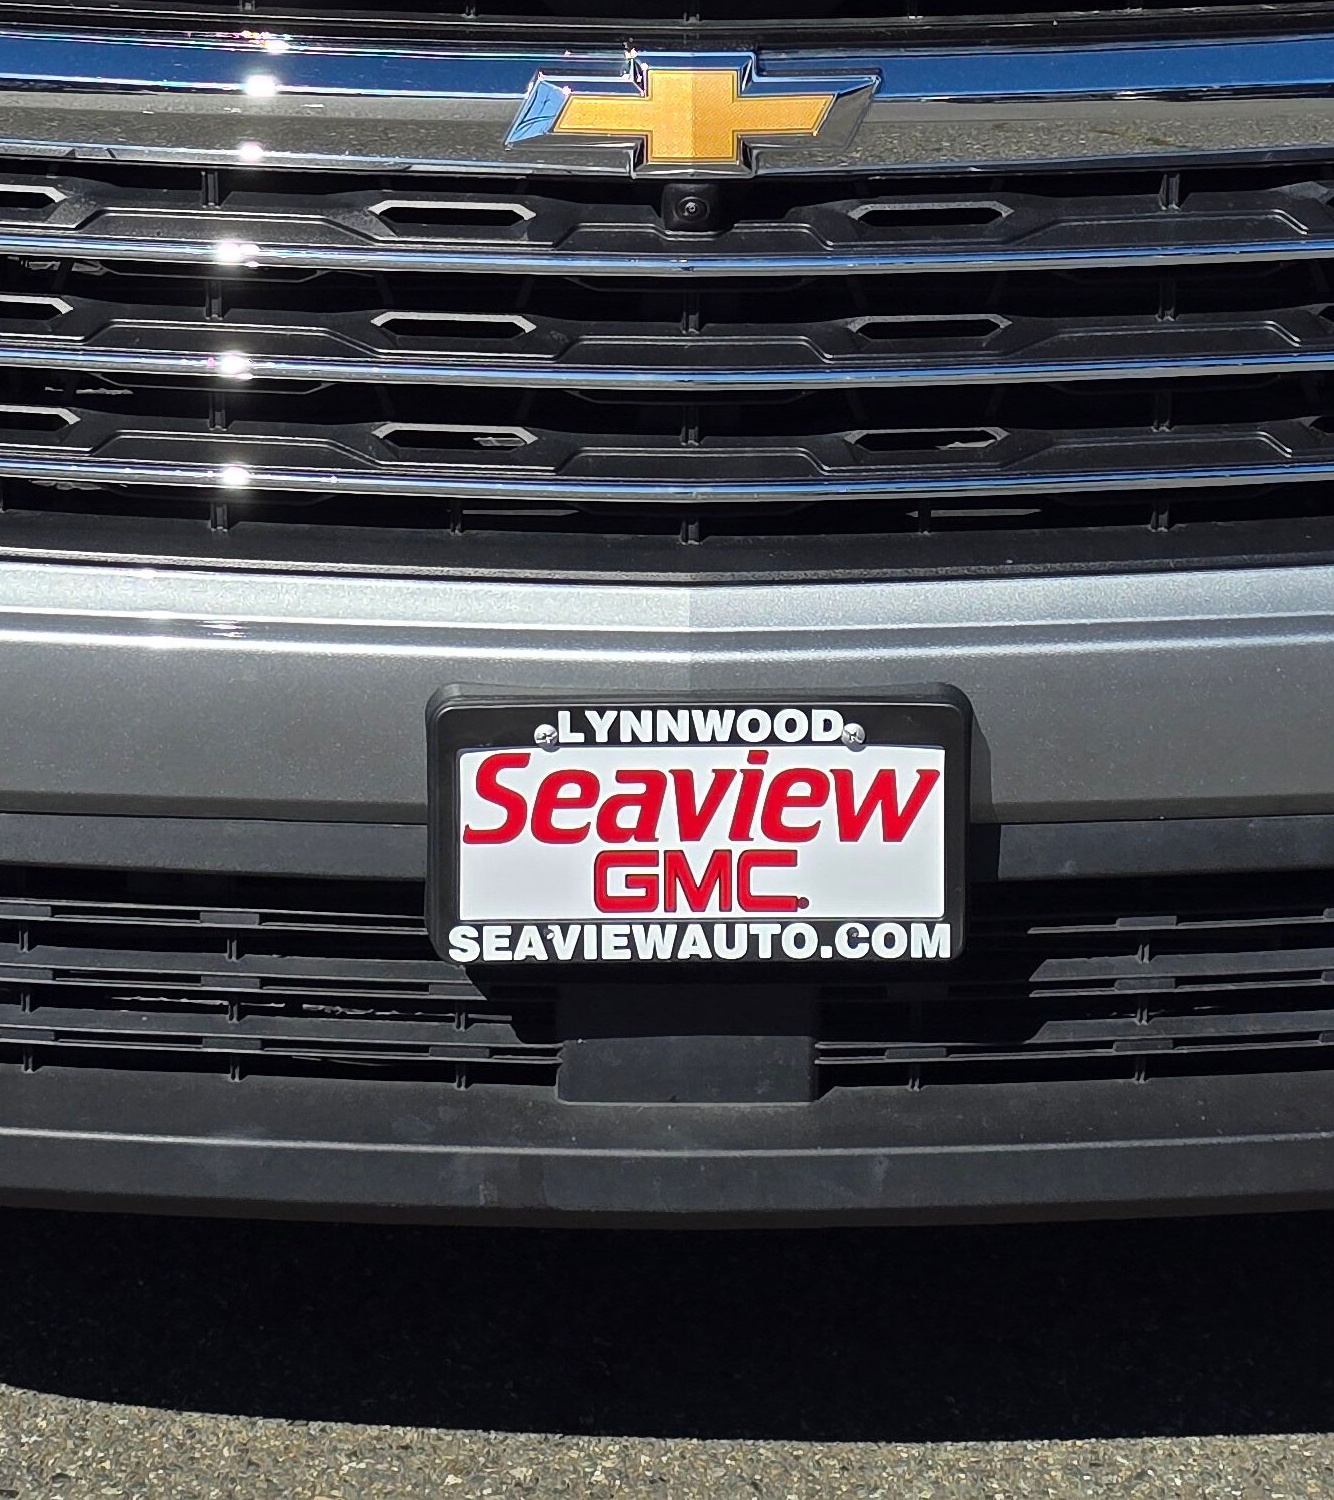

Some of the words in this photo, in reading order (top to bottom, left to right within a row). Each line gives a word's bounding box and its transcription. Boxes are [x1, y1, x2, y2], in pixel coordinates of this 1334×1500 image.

[557, 708, 845, 744] LYNNWOOD
[462, 749, 941, 844] Seaview
[593, 848, 801, 914] GMC
[447, 921, 952, 962] SEAVIEWAUTO.COM
